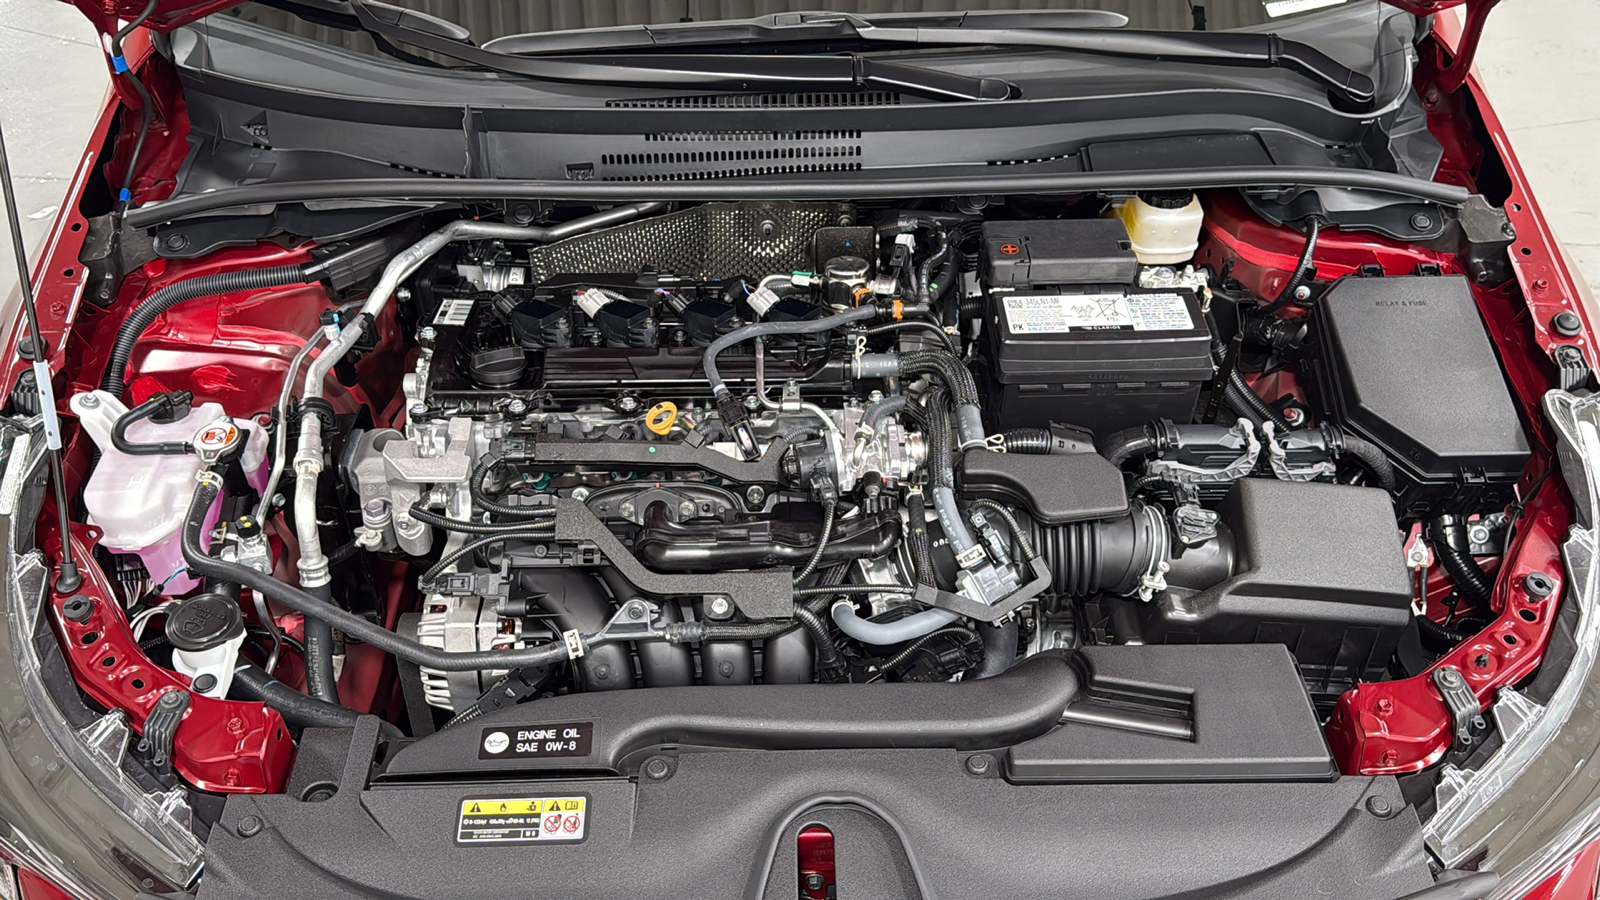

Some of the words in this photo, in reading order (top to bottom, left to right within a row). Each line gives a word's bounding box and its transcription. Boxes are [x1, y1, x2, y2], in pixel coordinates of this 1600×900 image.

[1013, 323, 1025, 331] PK
[517, 729, 556, 741] ENGINE
[563, 728, 580, 739] OIL
[515, 742, 538, 753] SAE
[546, 741, 577, 752] 0W-8
